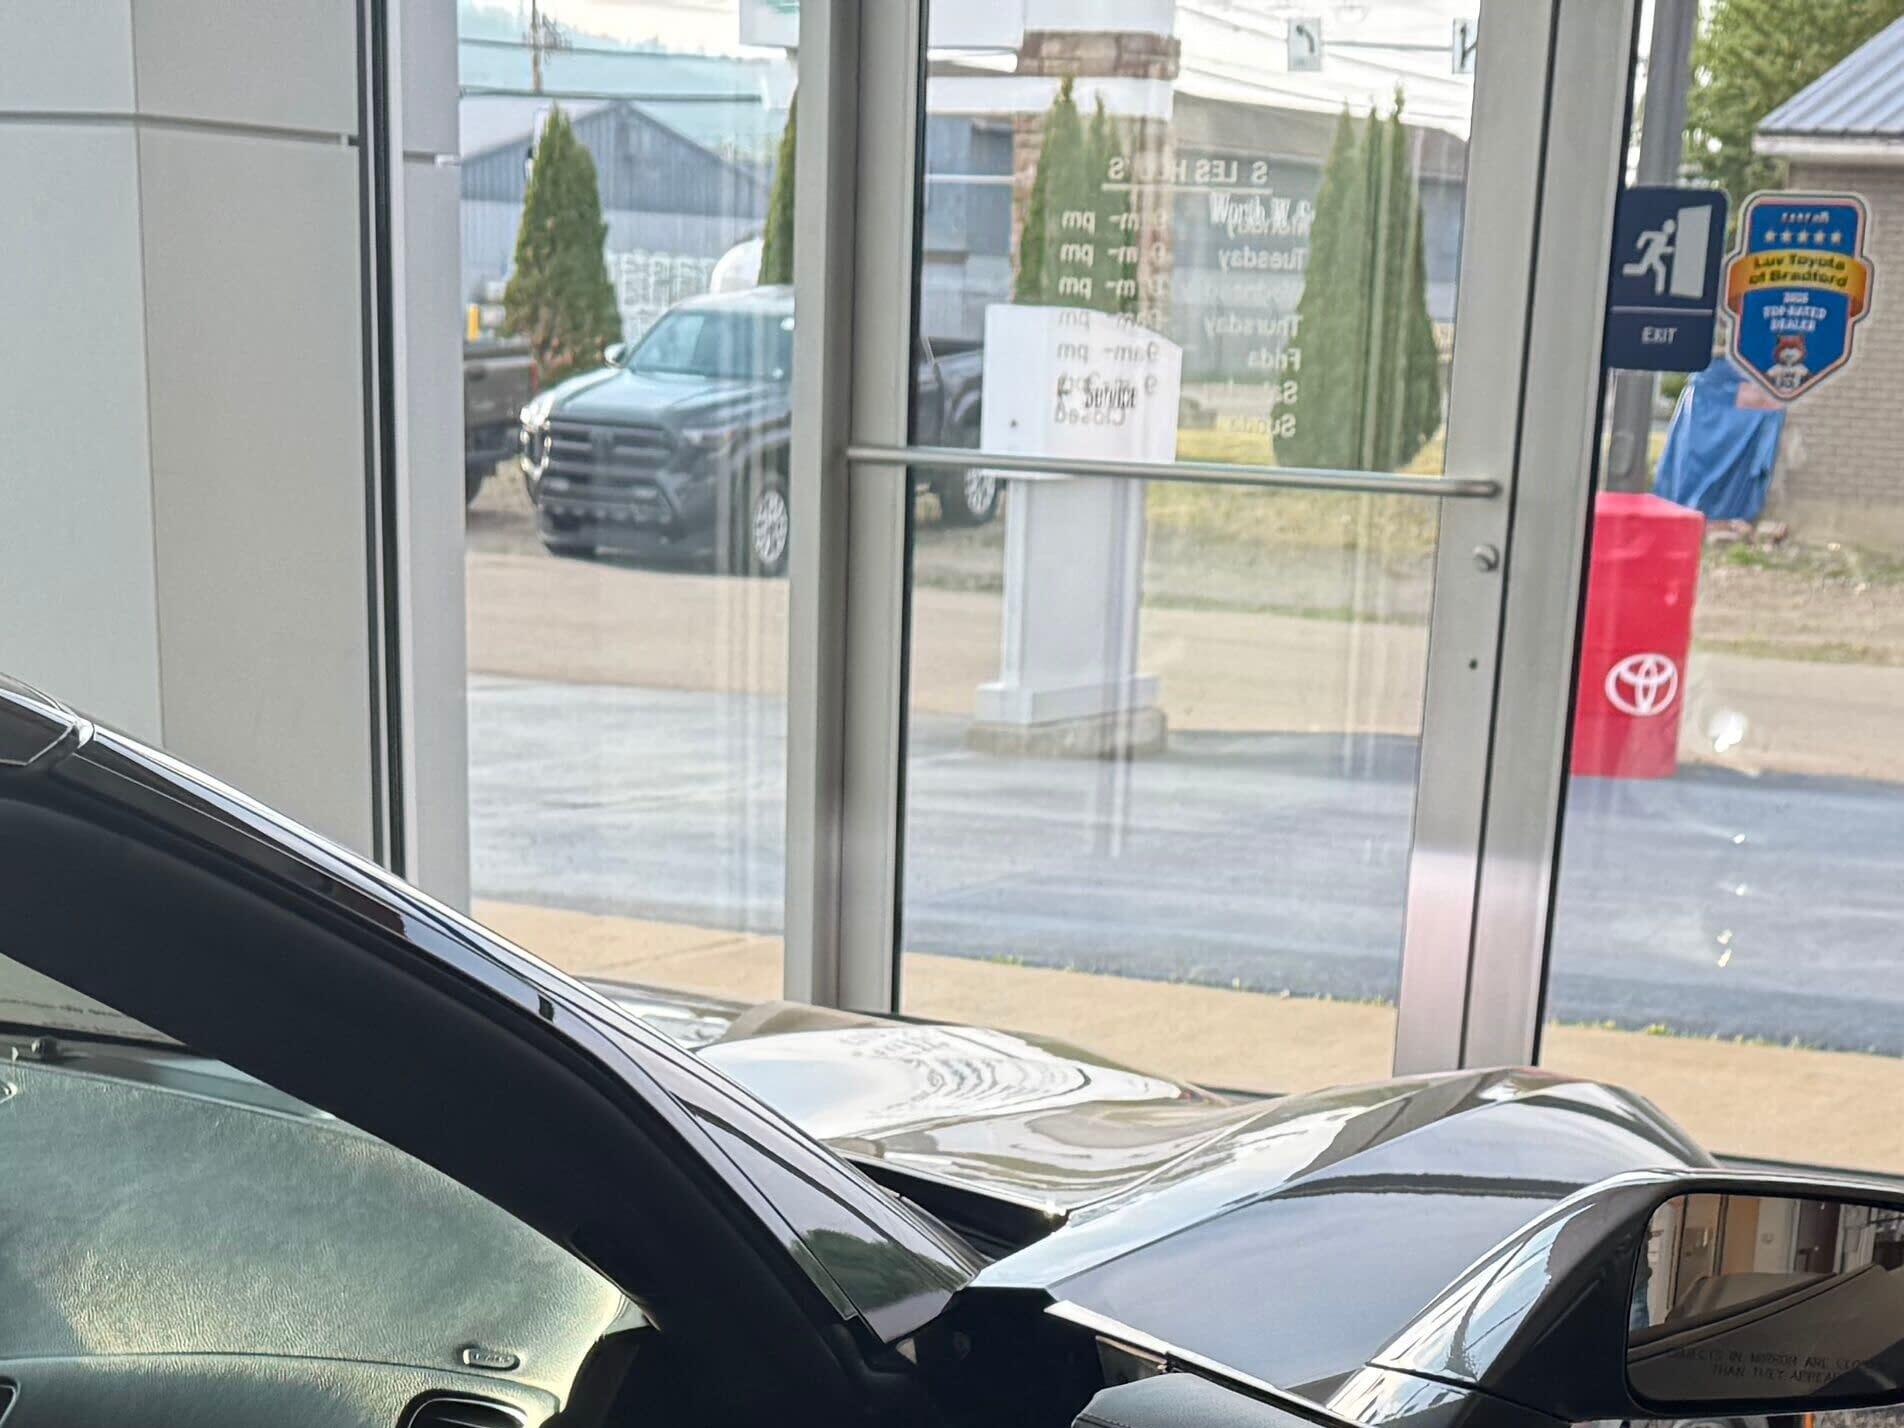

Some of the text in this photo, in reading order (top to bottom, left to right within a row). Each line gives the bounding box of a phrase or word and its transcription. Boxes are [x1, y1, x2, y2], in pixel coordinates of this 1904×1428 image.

[1789, 253, 1846, 271] Toyota
[1769, 269, 1849, 288] Bradford
[1641, 326, 1677, 344] EXIT
[1790, 1369, 1839, 1384] APPEA
